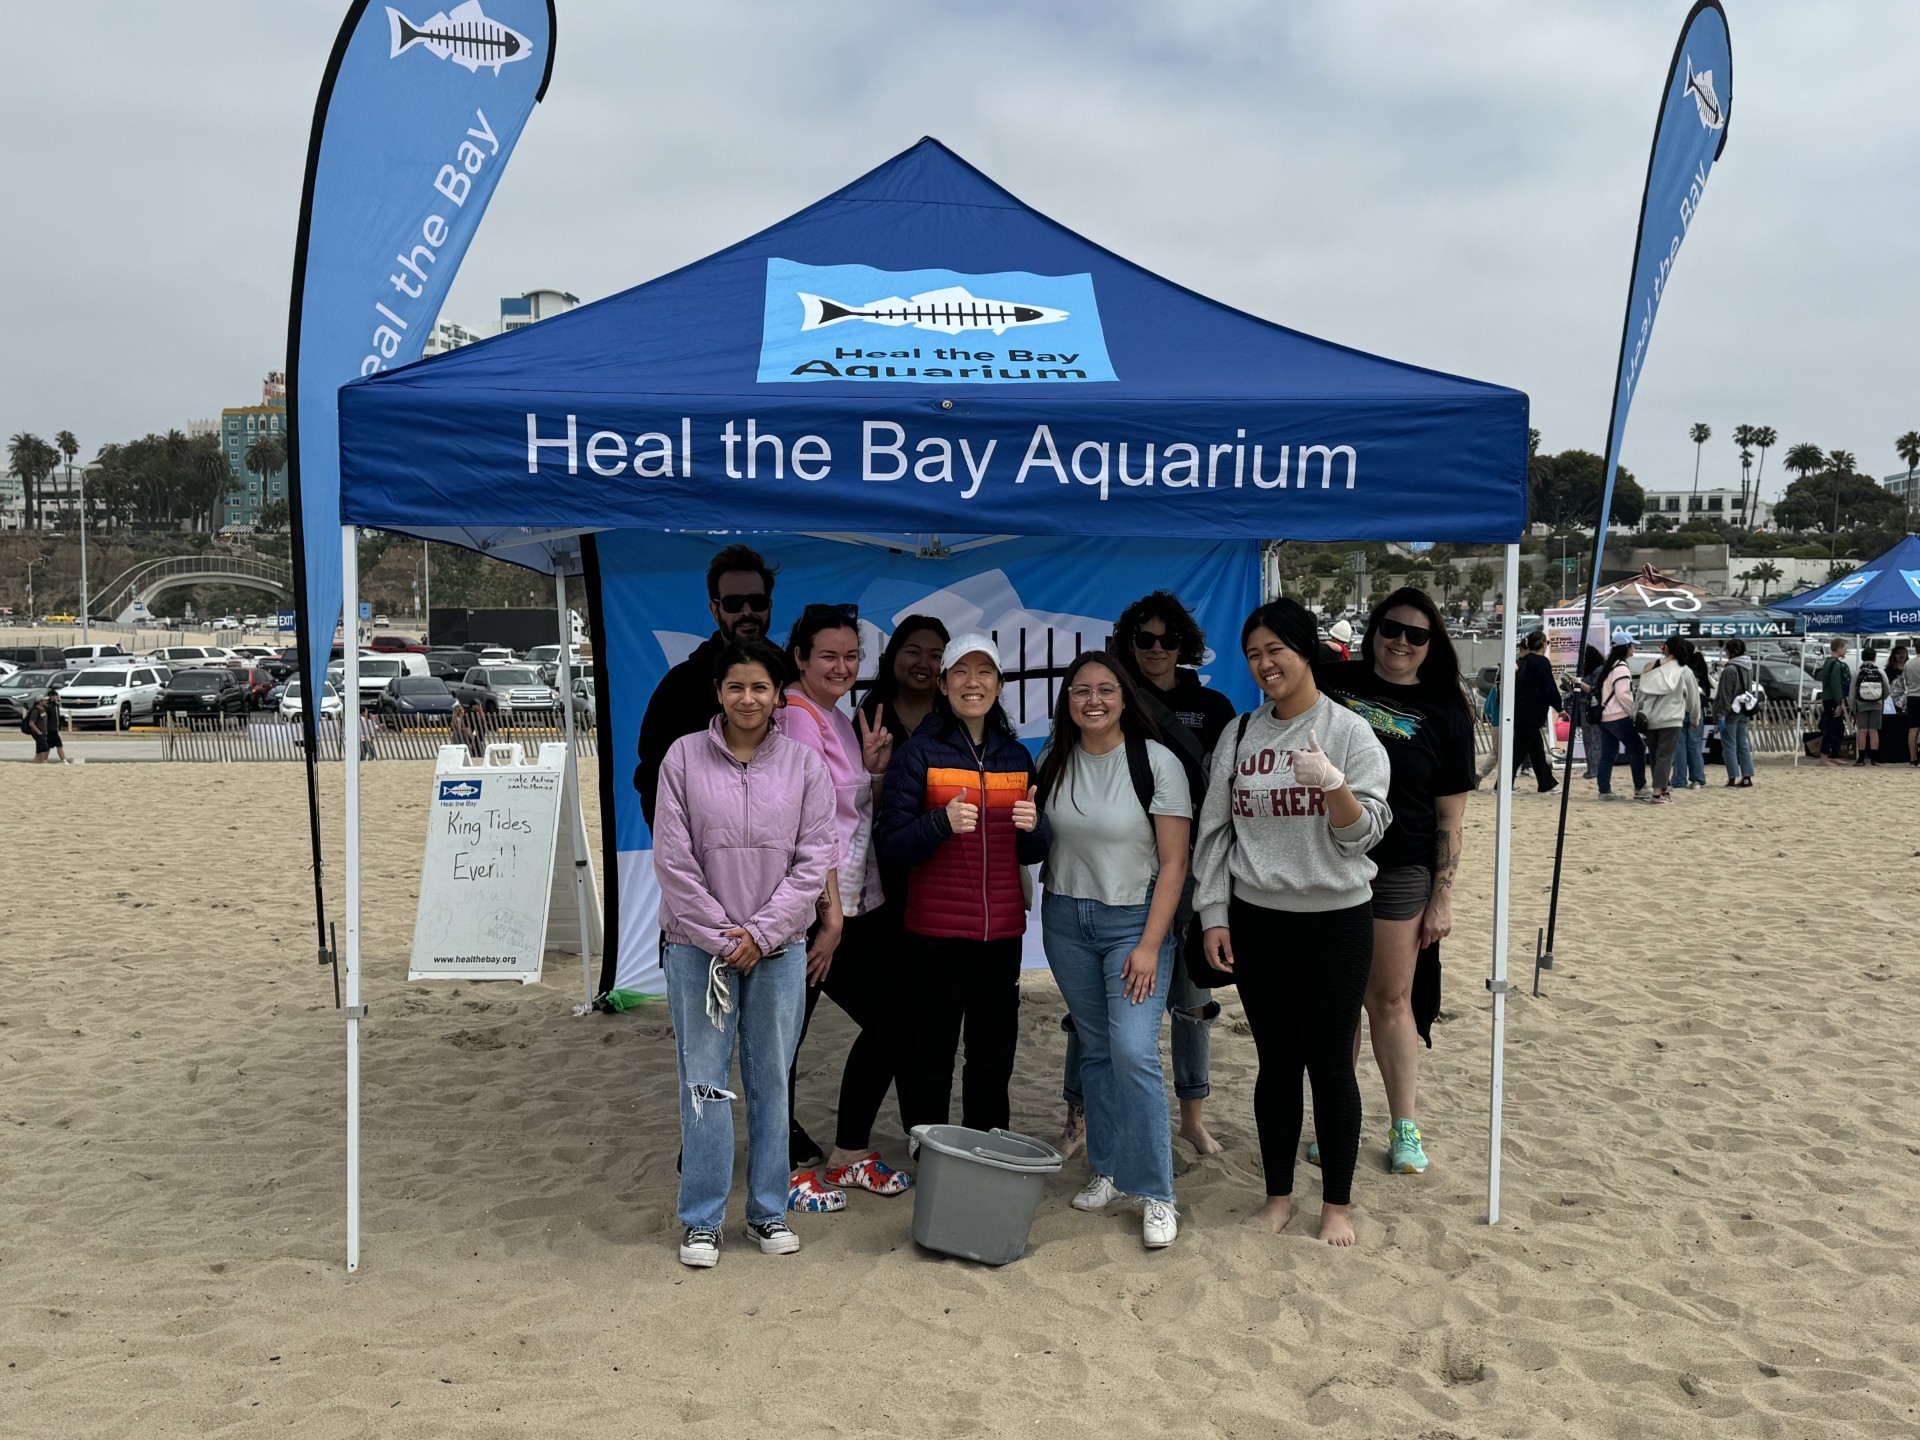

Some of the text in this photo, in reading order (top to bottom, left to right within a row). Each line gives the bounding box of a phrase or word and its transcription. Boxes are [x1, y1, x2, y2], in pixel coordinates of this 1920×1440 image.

[360, 108, 500, 377] eal the Bay
[835, 347, 1080, 365] Heal the Bay
[790, 359, 1088, 379] Aquarium
[526, 413, 1358, 501] Heal the Bay Aquarium
[279, 615, 294, 626] EXIT
[1811, 611, 1844, 627] Aquarium
[1611, 622, 1792, 636] ACHLIFE FESTIVAL
[447, 807, 532, 846] King Tides
[433, 955, 517, 965] www.healthebay.org
